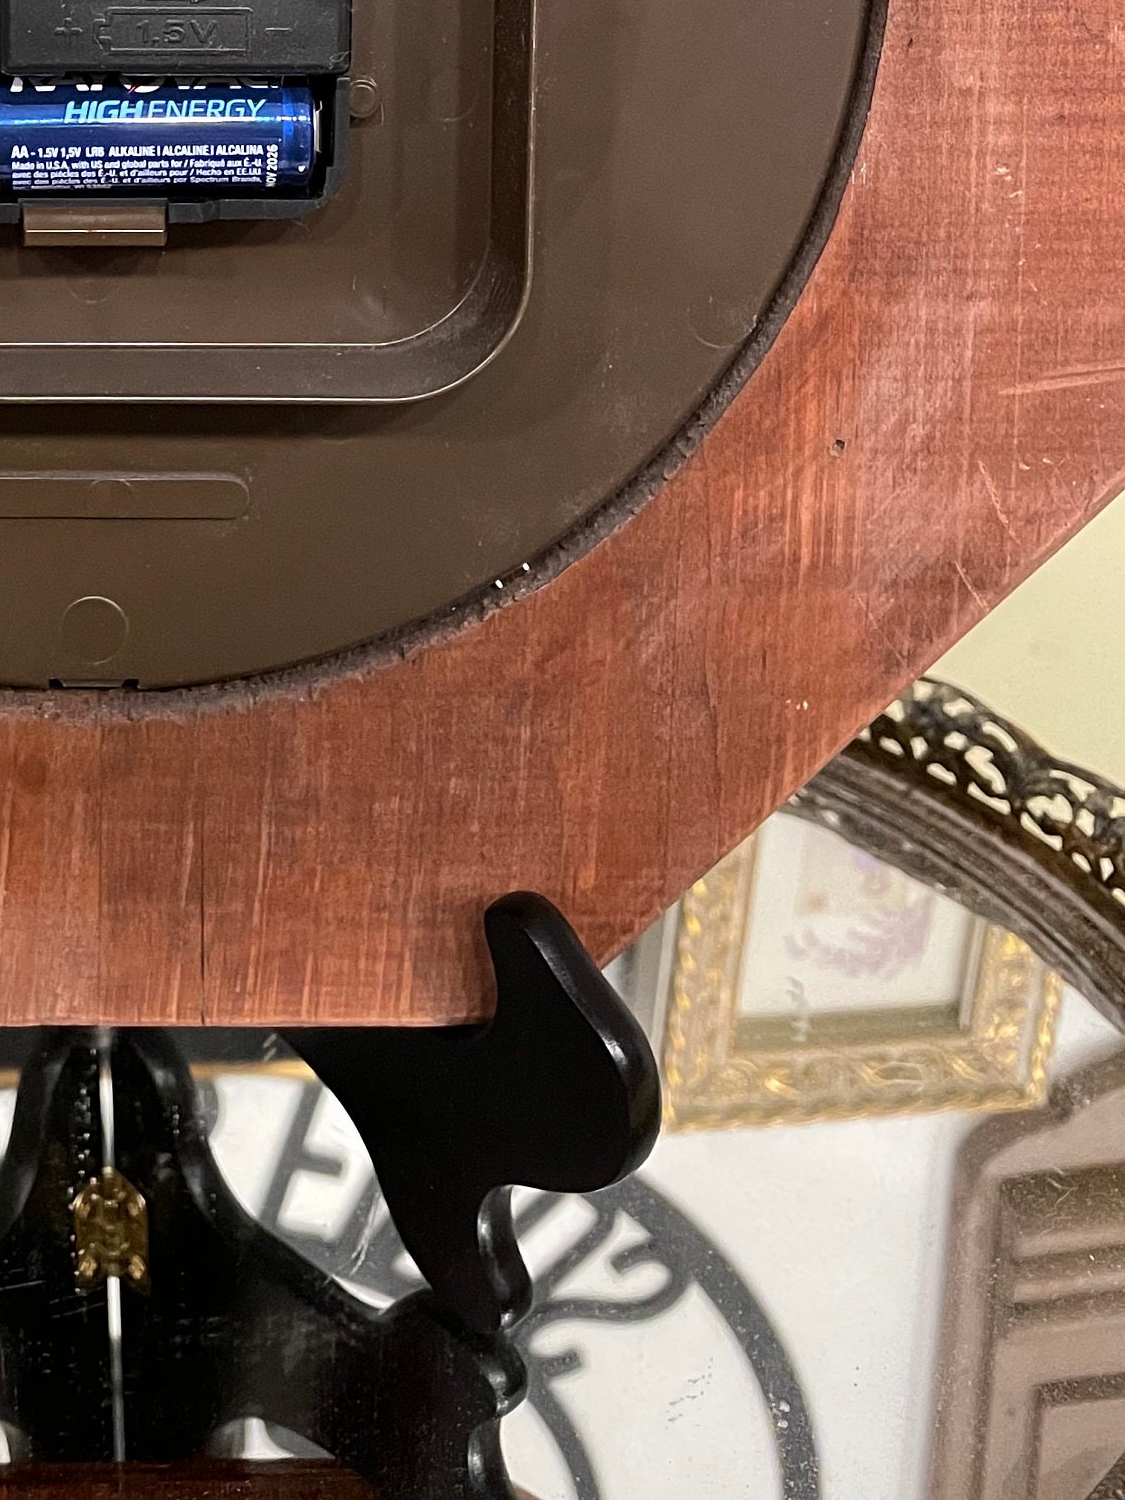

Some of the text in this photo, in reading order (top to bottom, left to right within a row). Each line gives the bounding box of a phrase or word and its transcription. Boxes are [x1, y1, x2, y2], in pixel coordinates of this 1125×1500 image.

[11, 145, 29, 158] AA
[38, 147, 59, 158] 1.5V
[108, 146, 155, 157] ALKALINE
[162, 144, 210, 156] ALCALINE
[216, 144, 264, 155] ALCALINA
[266, 144, 279, 171] 2026
[12, 161, 35, 170] Made
[36, 161, 44, 169] in
[71, 161, 90, 169] with
[91, 160, 103, 169] US
[104, 160, 120, 169] and
[121, 160, 146, 170] global
[148, 160, 169, 169] parts
[171, 159, 182, 168] for
